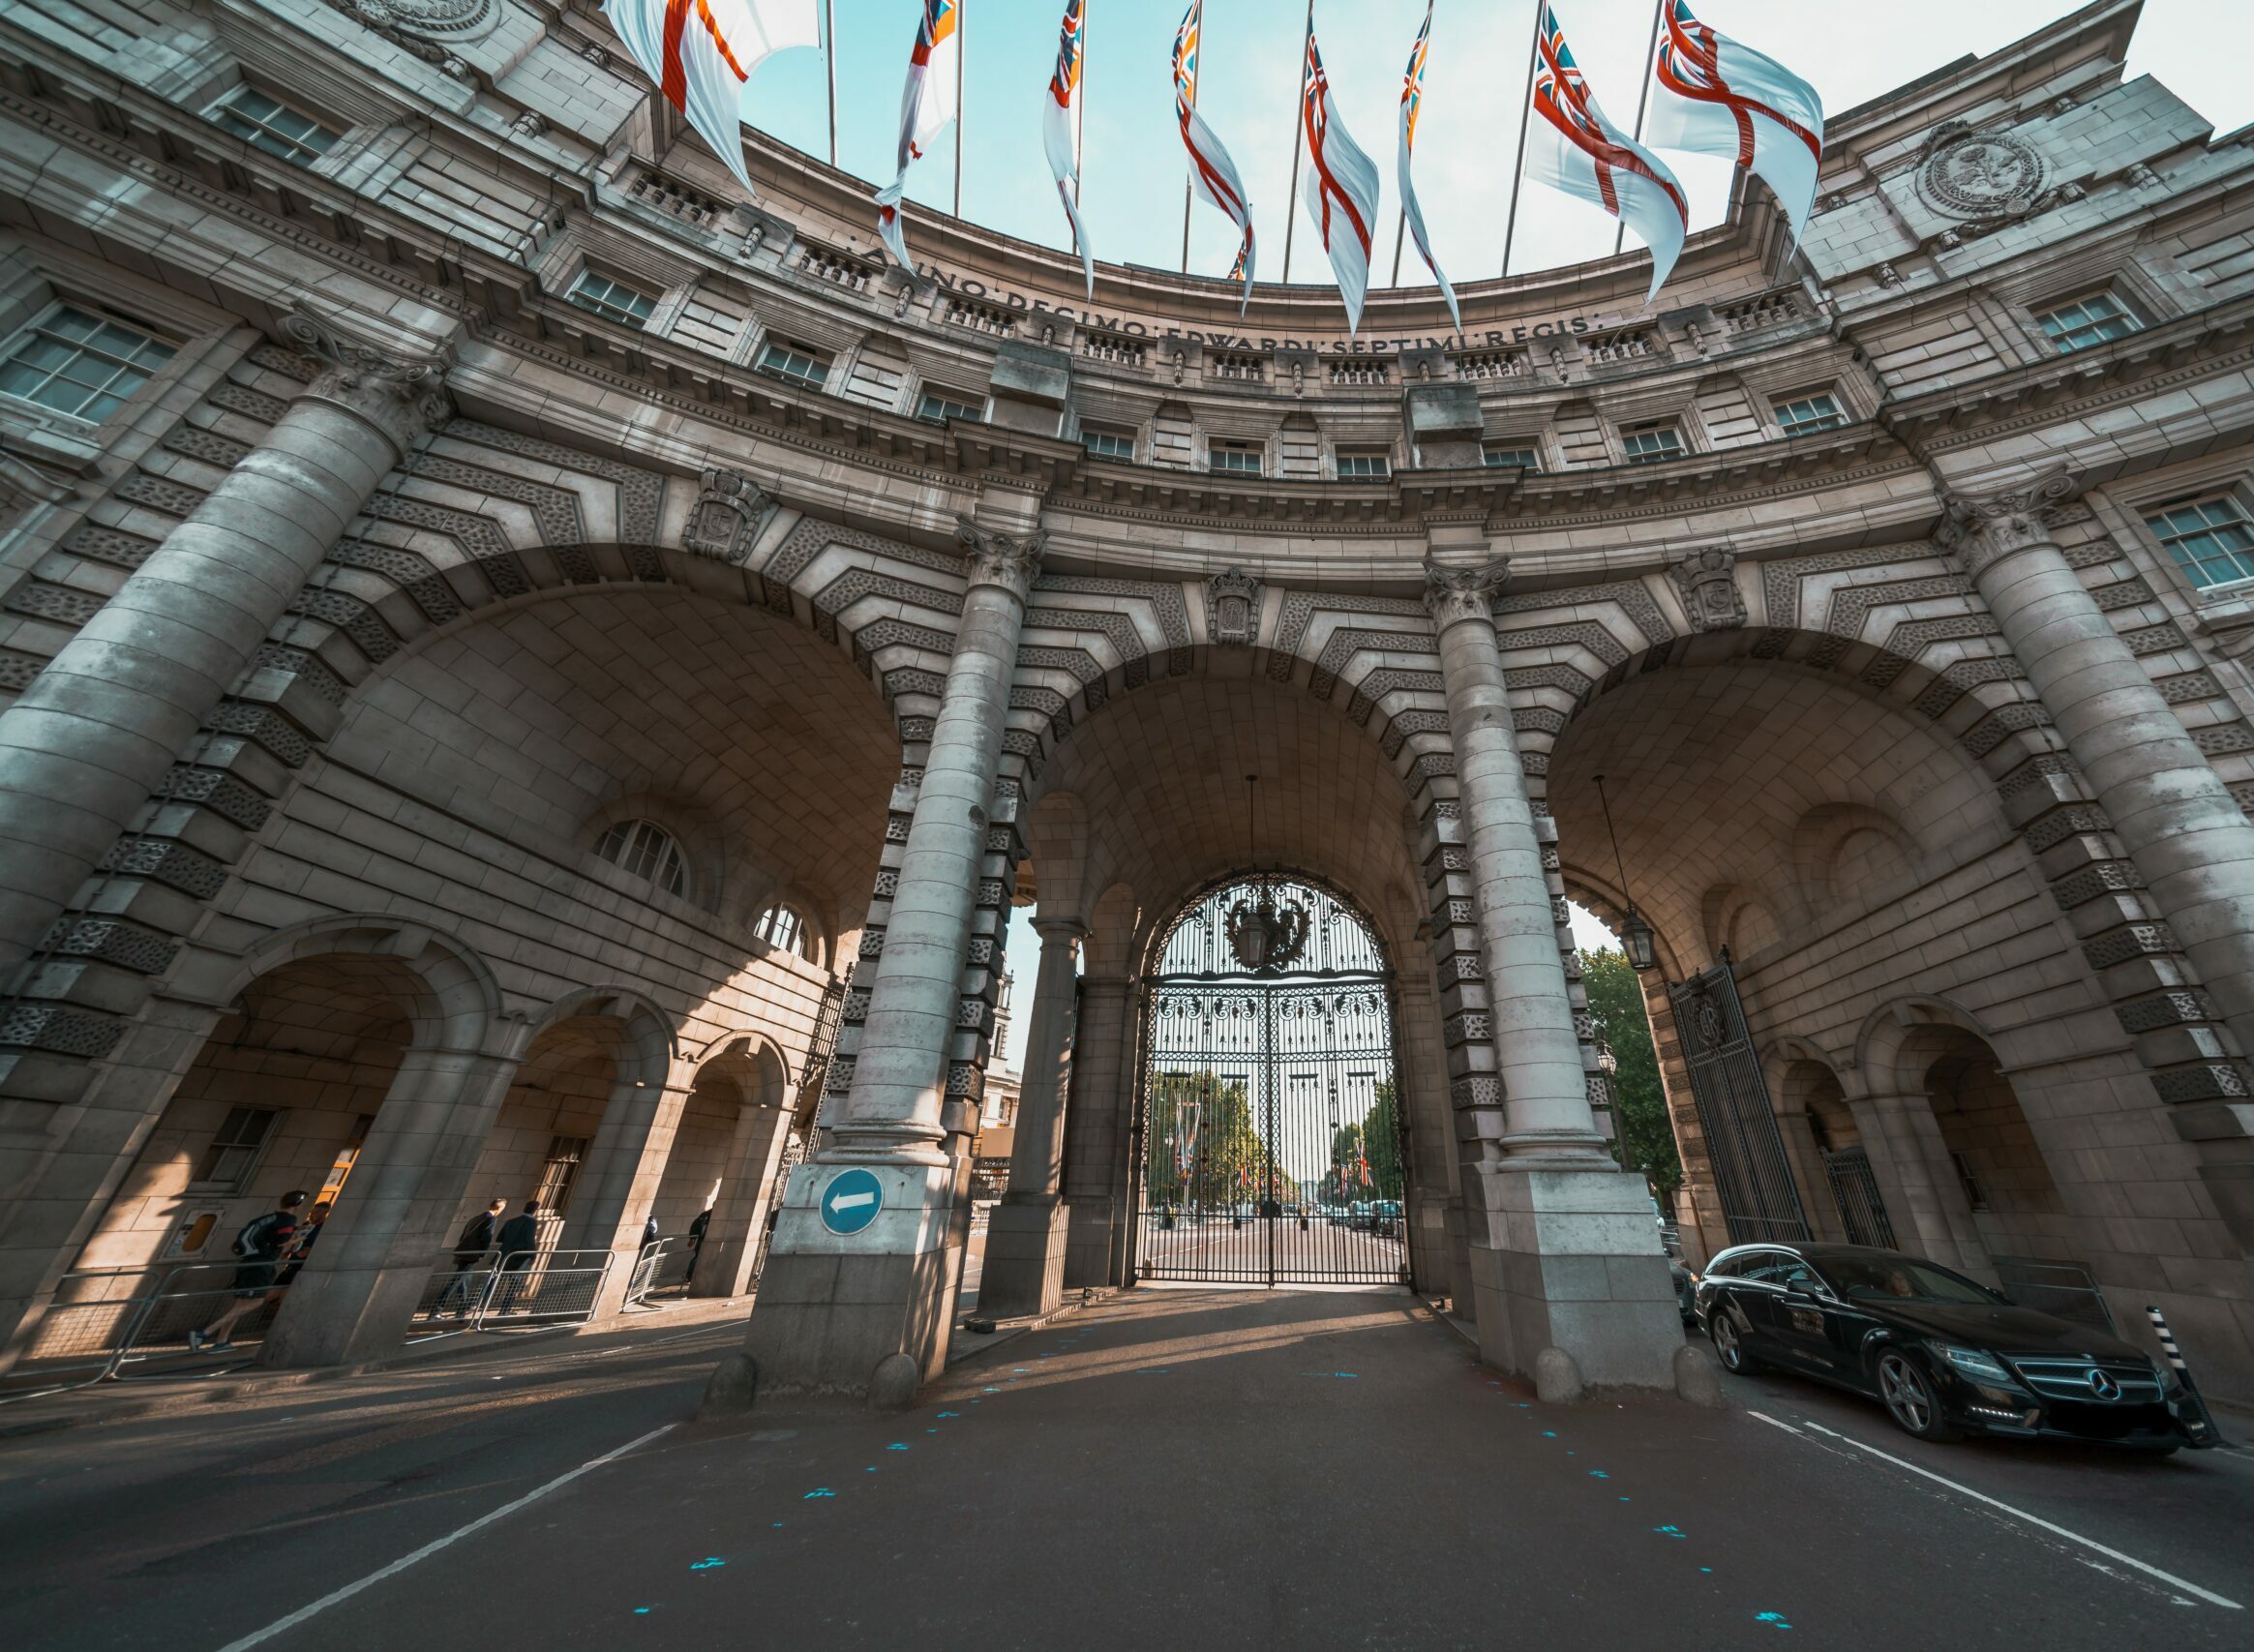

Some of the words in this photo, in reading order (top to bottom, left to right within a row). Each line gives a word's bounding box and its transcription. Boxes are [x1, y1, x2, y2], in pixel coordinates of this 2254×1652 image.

[1167, 327, 1312, 351] EDWARDI
[1333, 334, 1467, 355] SEPTIMI
[1485, 316, 1588, 347] REGIS
